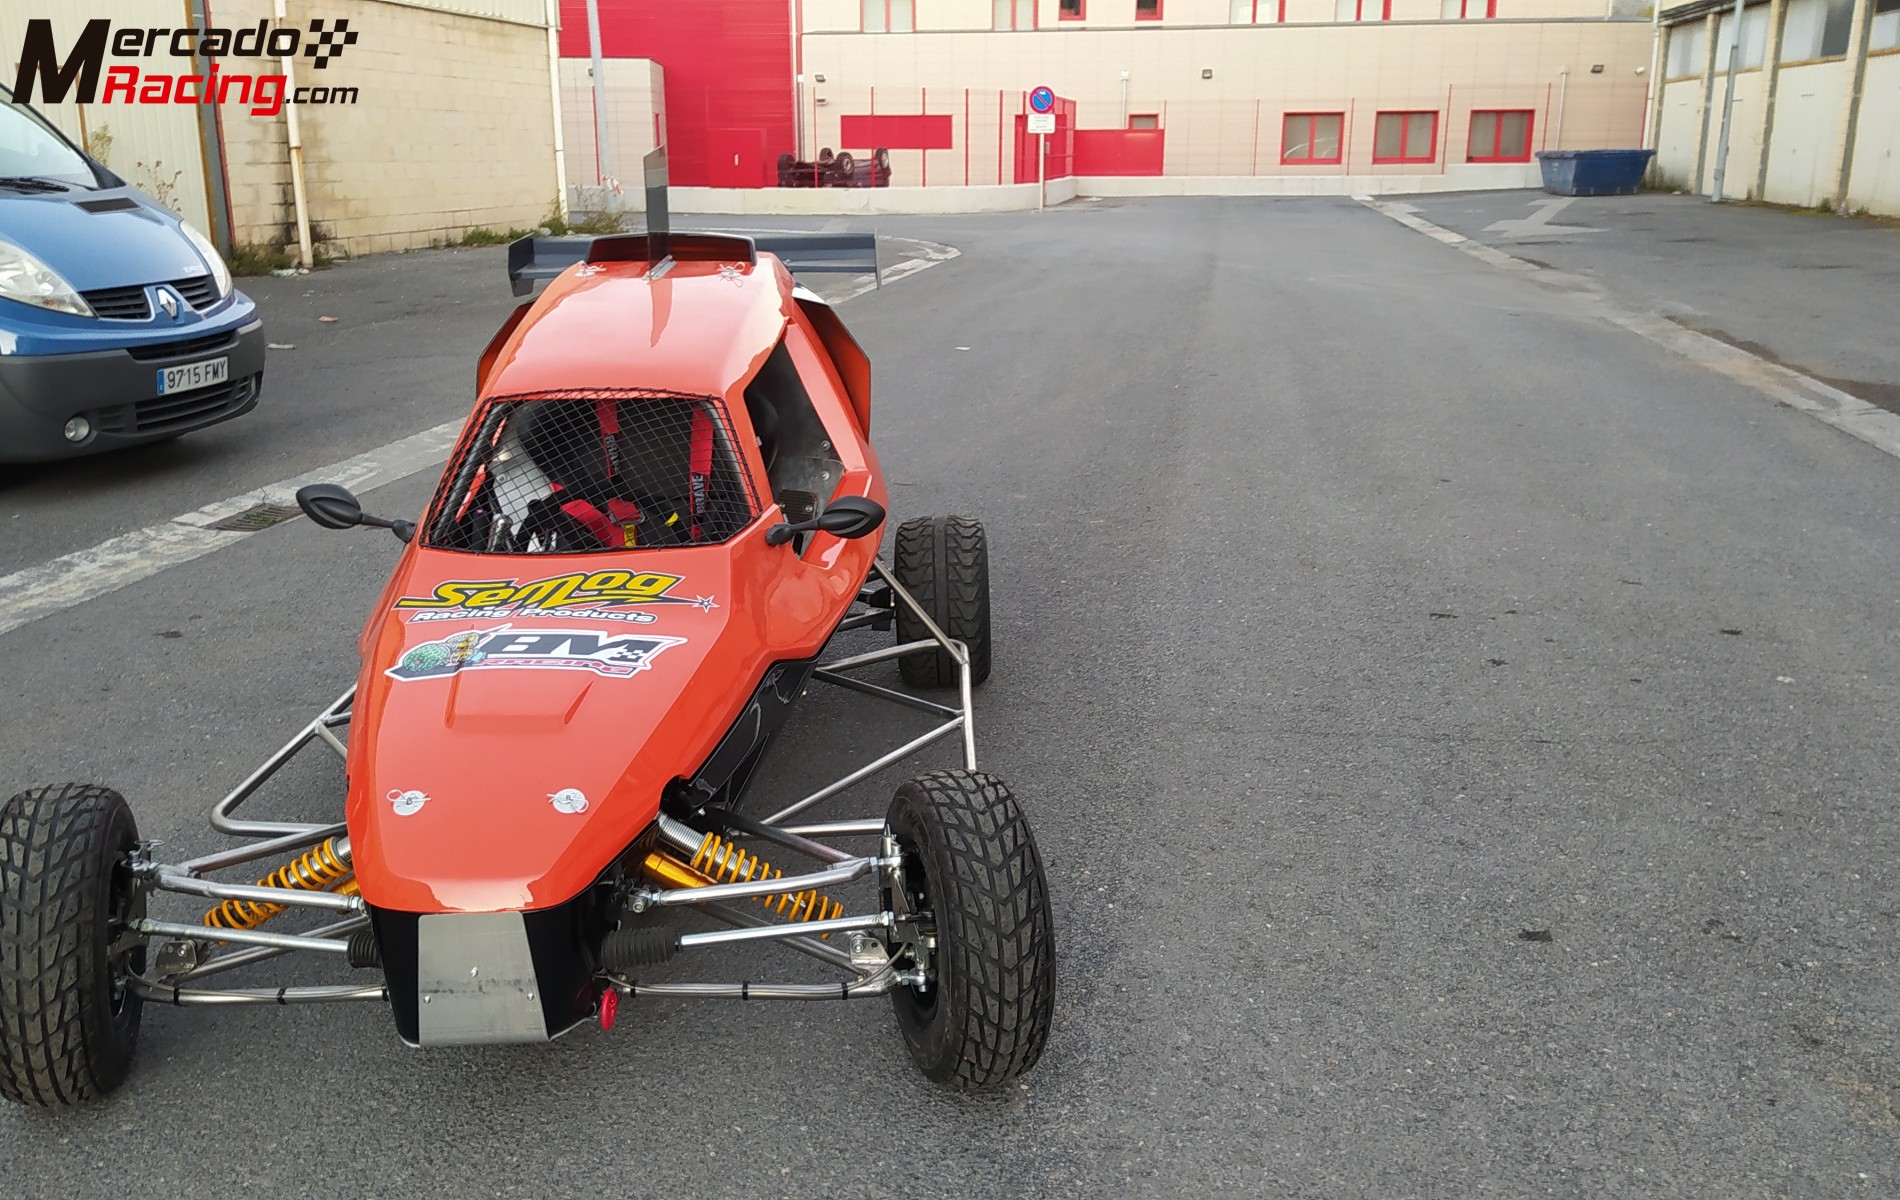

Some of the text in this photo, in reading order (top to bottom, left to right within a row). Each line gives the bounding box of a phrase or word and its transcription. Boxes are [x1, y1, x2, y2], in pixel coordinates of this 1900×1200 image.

[167, 360, 226, 389] 9715 FMY
[691, 474, 705, 514] BRAVE
[411, 606, 656, 622] Racing Products
